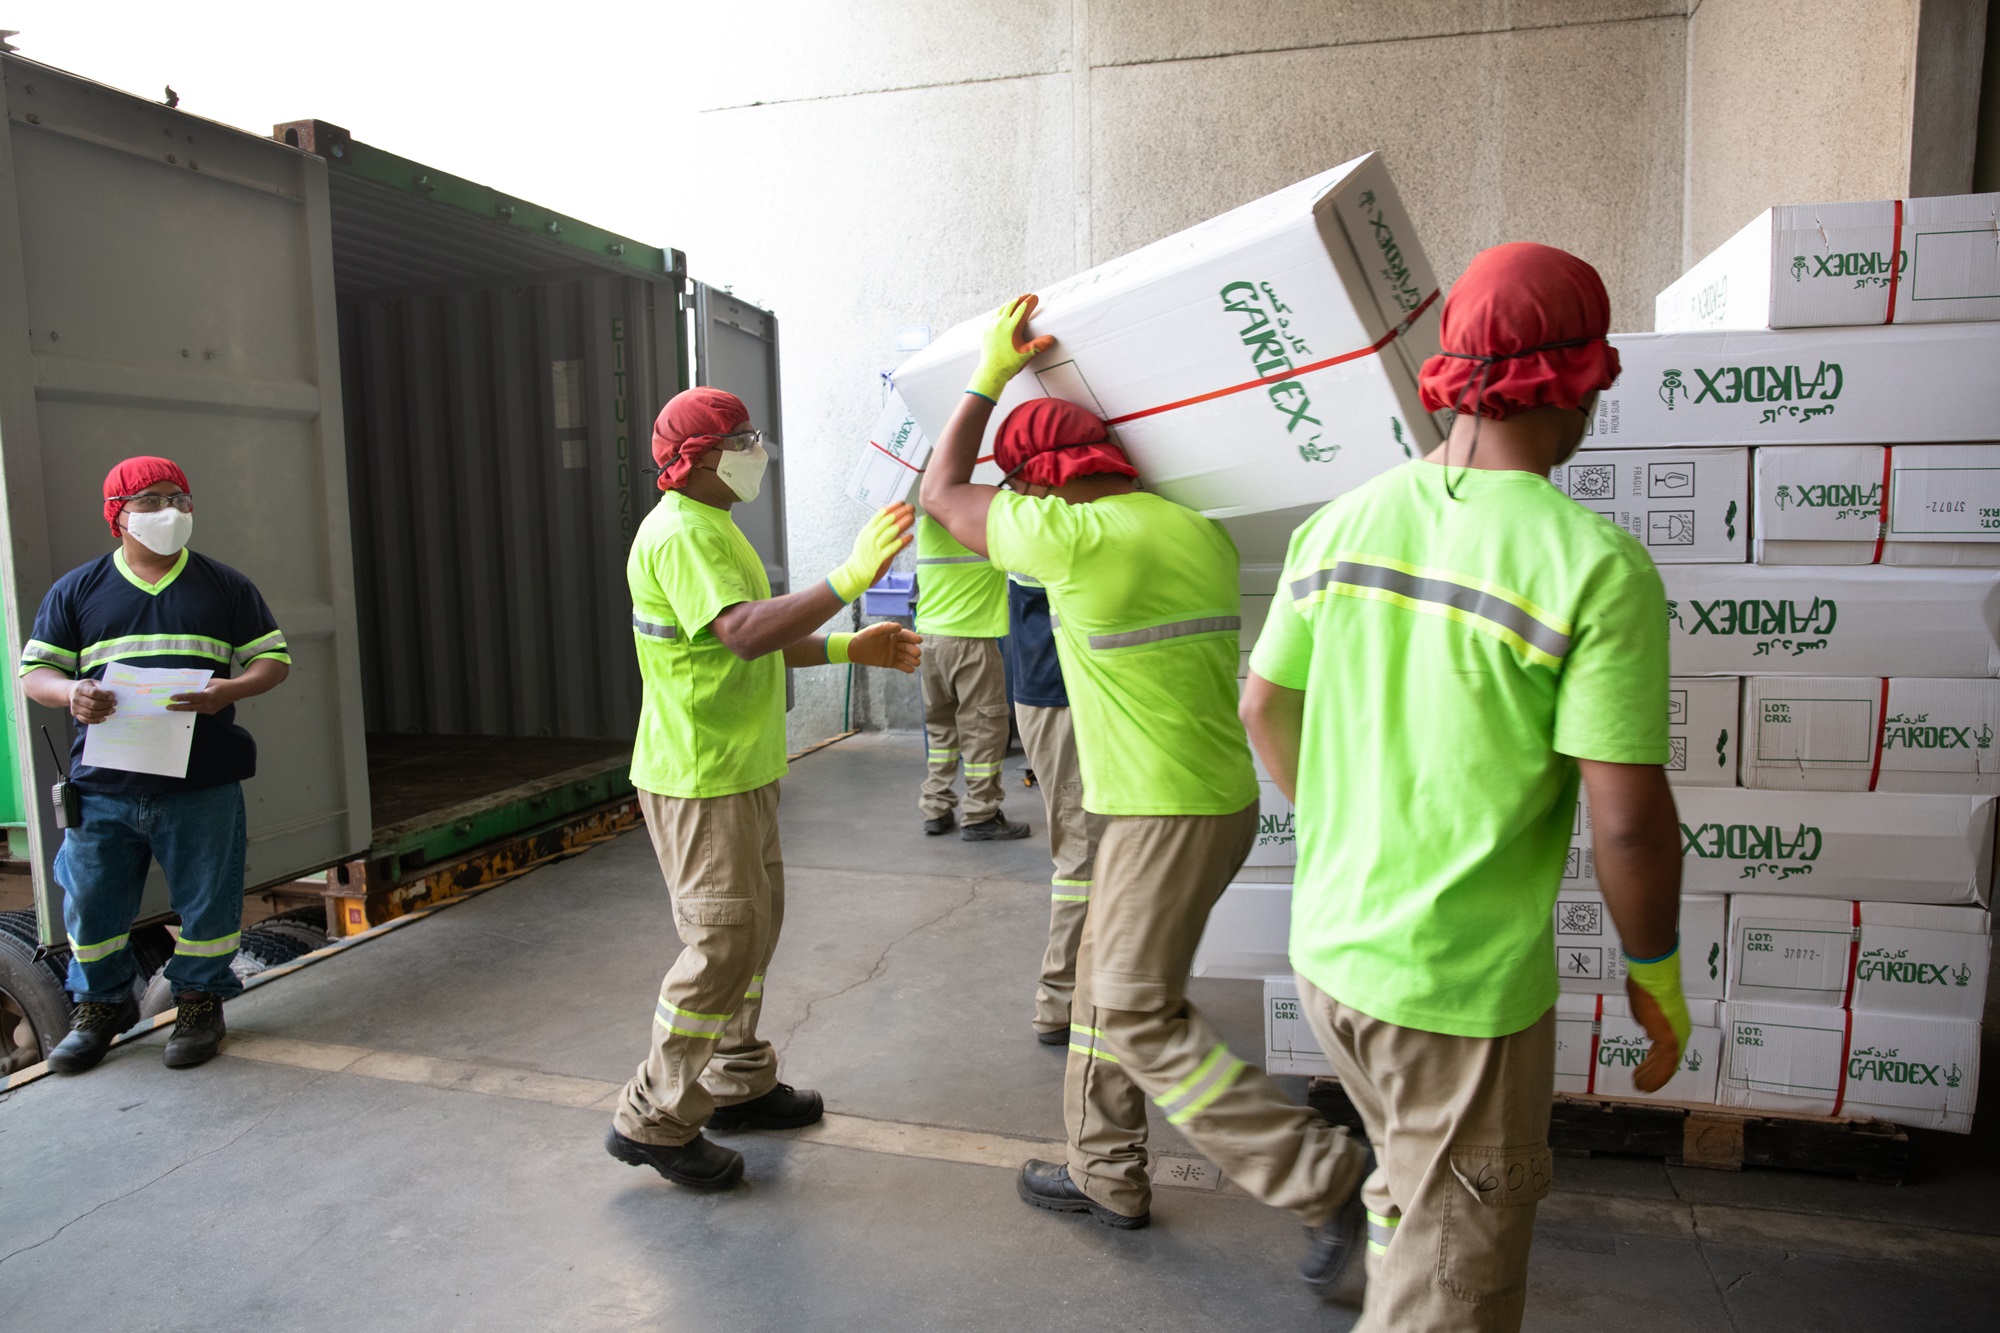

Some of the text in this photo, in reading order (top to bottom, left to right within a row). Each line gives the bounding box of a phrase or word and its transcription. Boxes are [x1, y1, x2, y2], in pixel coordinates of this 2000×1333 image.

[1813, 250, 1908, 278] CARDEX
[1219, 281, 1323, 433] CARDEX
[612, 317, 627, 423] EITU
[1693, 360, 1844, 404] CARDEX
[1599, 400, 1608, 435] KEEP AWAY
[1611, 400, 1620, 434] FROM SUN
[1632, 466, 1642, 497] FRAGILE
[1979, 508, 2000, 518] RX:
[1632, 516, 1641, 533] KEEP
[1980, 519, 2000, 529] OT:
[1688, 595, 1837, 635] CARDEX
[1764, 703, 1790, 713] LOT:
[1764, 714, 1791, 723] CRX:
[1679, 822, 1823, 861] CARDEX
[1584, 864, 1593, 879] KEEP
[1747, 933, 1772, 942] LOT:
[1747, 943, 1774, 952] CRX:
[1784, 948, 1820, 960] 37072-
[1607, 947, 1616, 980] DRY PLACE
[1856, 959, 1949, 986] CARDEX
[1275, 1002, 1297, 1010] LOT:
[1275, 1011, 1299, 1020] CRX:
[1737, 1026, 1763, 1036] LOT:
[1736, 1037, 1764, 1047] CRX:
[1848, 1057, 1940, 1087] CARDEX
